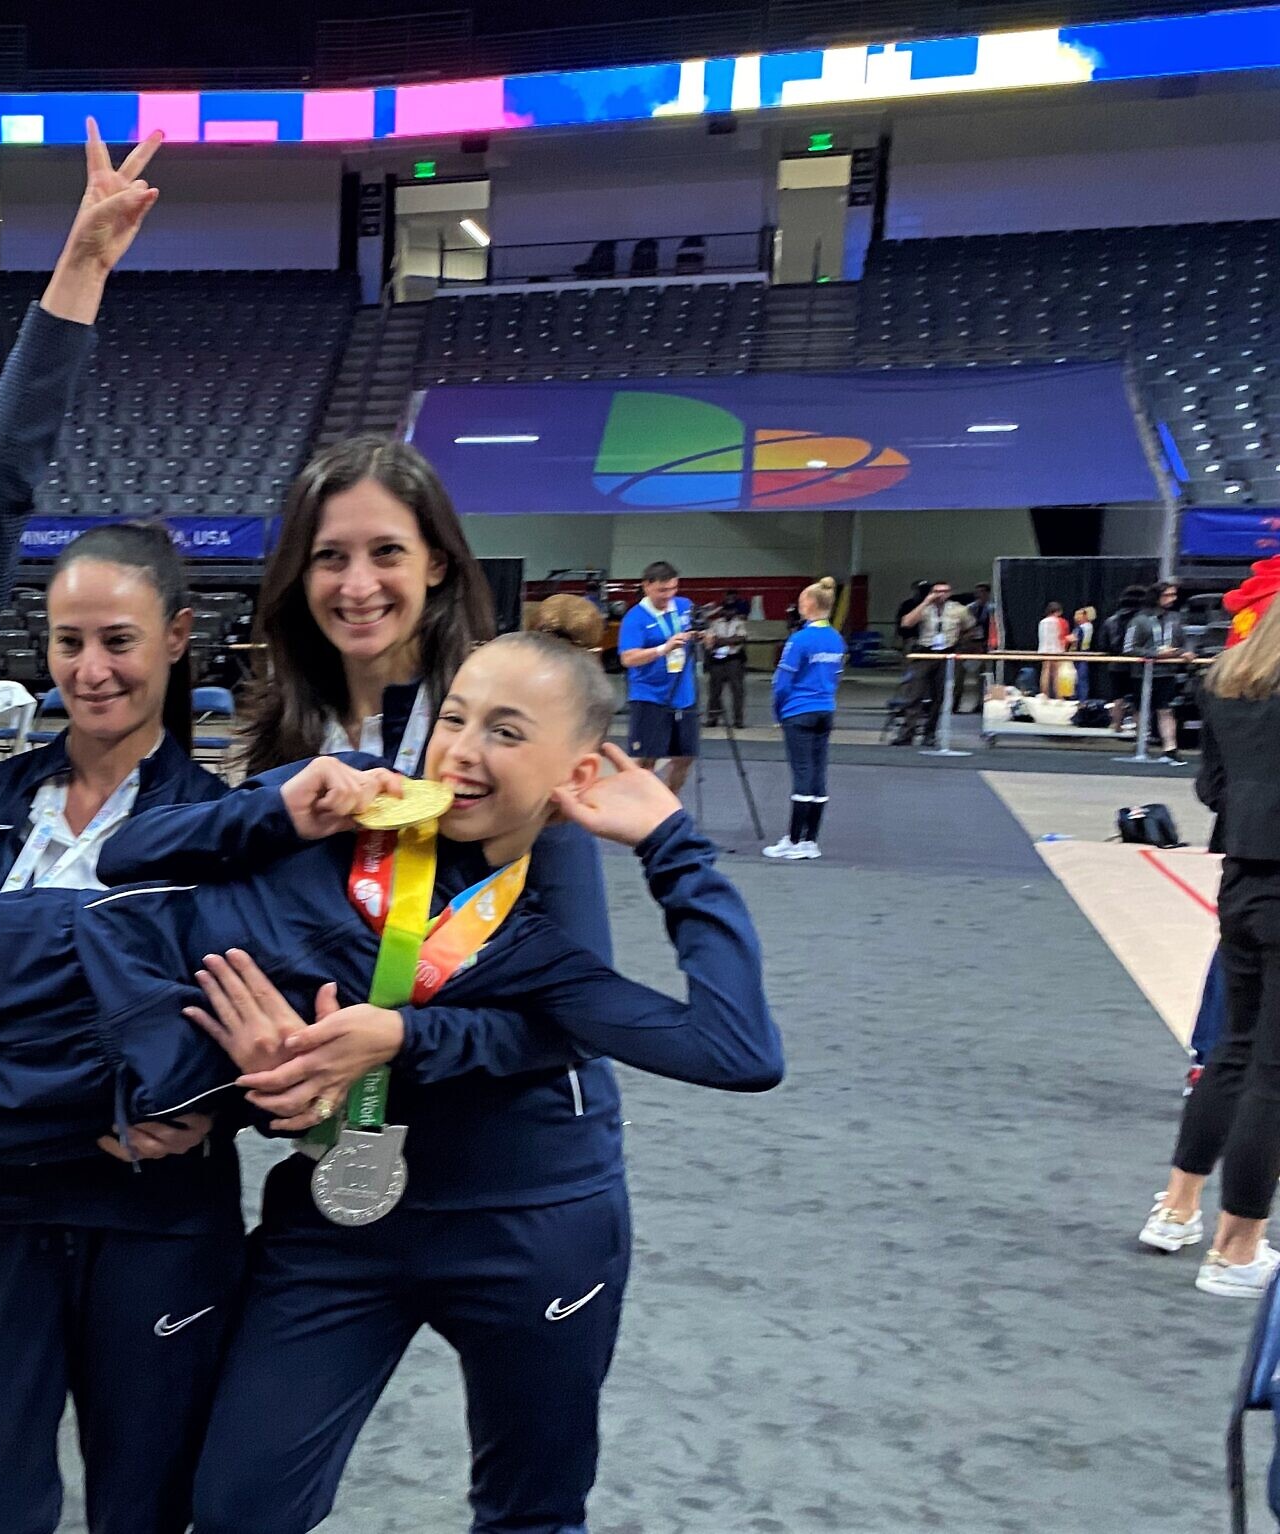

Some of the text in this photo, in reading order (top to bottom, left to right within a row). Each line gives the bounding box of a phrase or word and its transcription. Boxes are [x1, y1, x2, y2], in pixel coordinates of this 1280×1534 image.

[19, 530, 87, 545] MINGHA
[193, 531, 231, 545] USA
[362, 1071, 384, 1092] The
